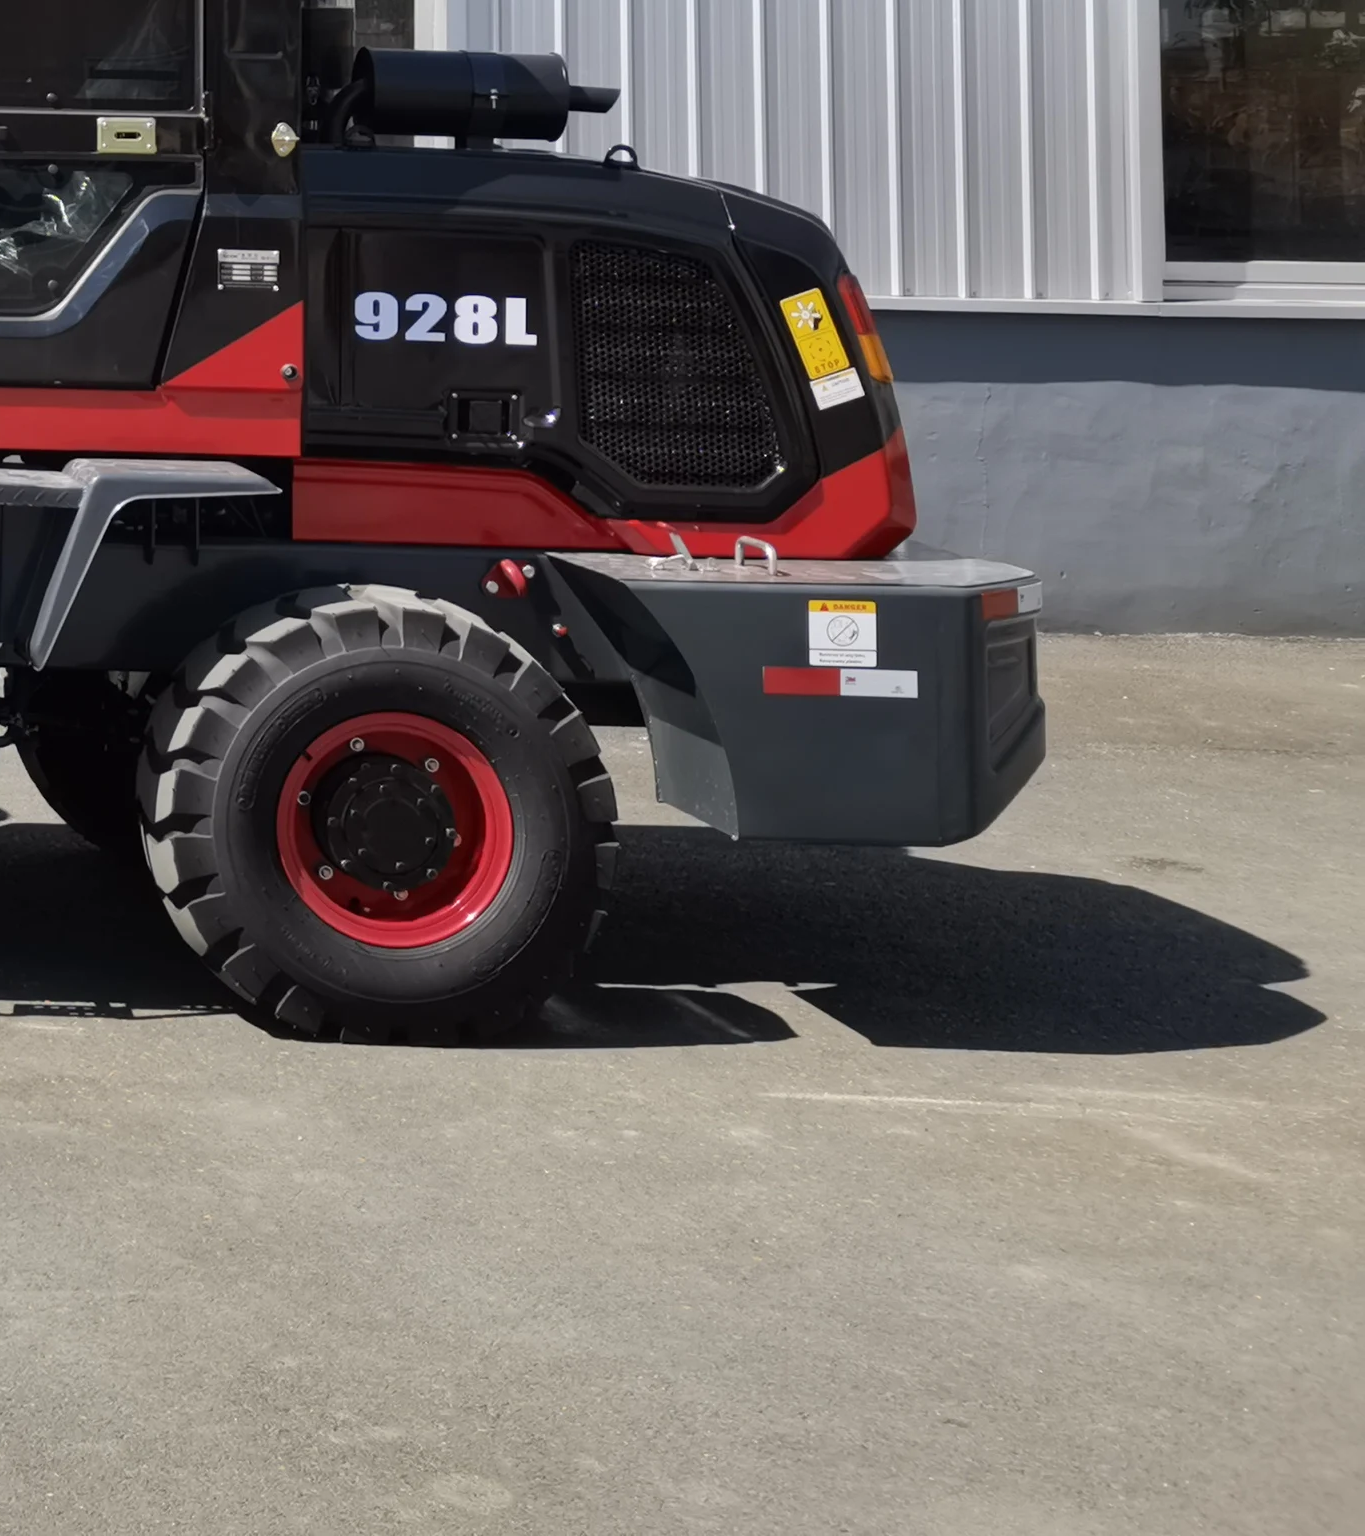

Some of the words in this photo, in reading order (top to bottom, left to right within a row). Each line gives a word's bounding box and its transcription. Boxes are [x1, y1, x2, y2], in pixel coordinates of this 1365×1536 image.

[354, 291, 538, 346] 928L
[814, 358, 840, 373] STOP
[833, 603, 867, 611] DANGER
